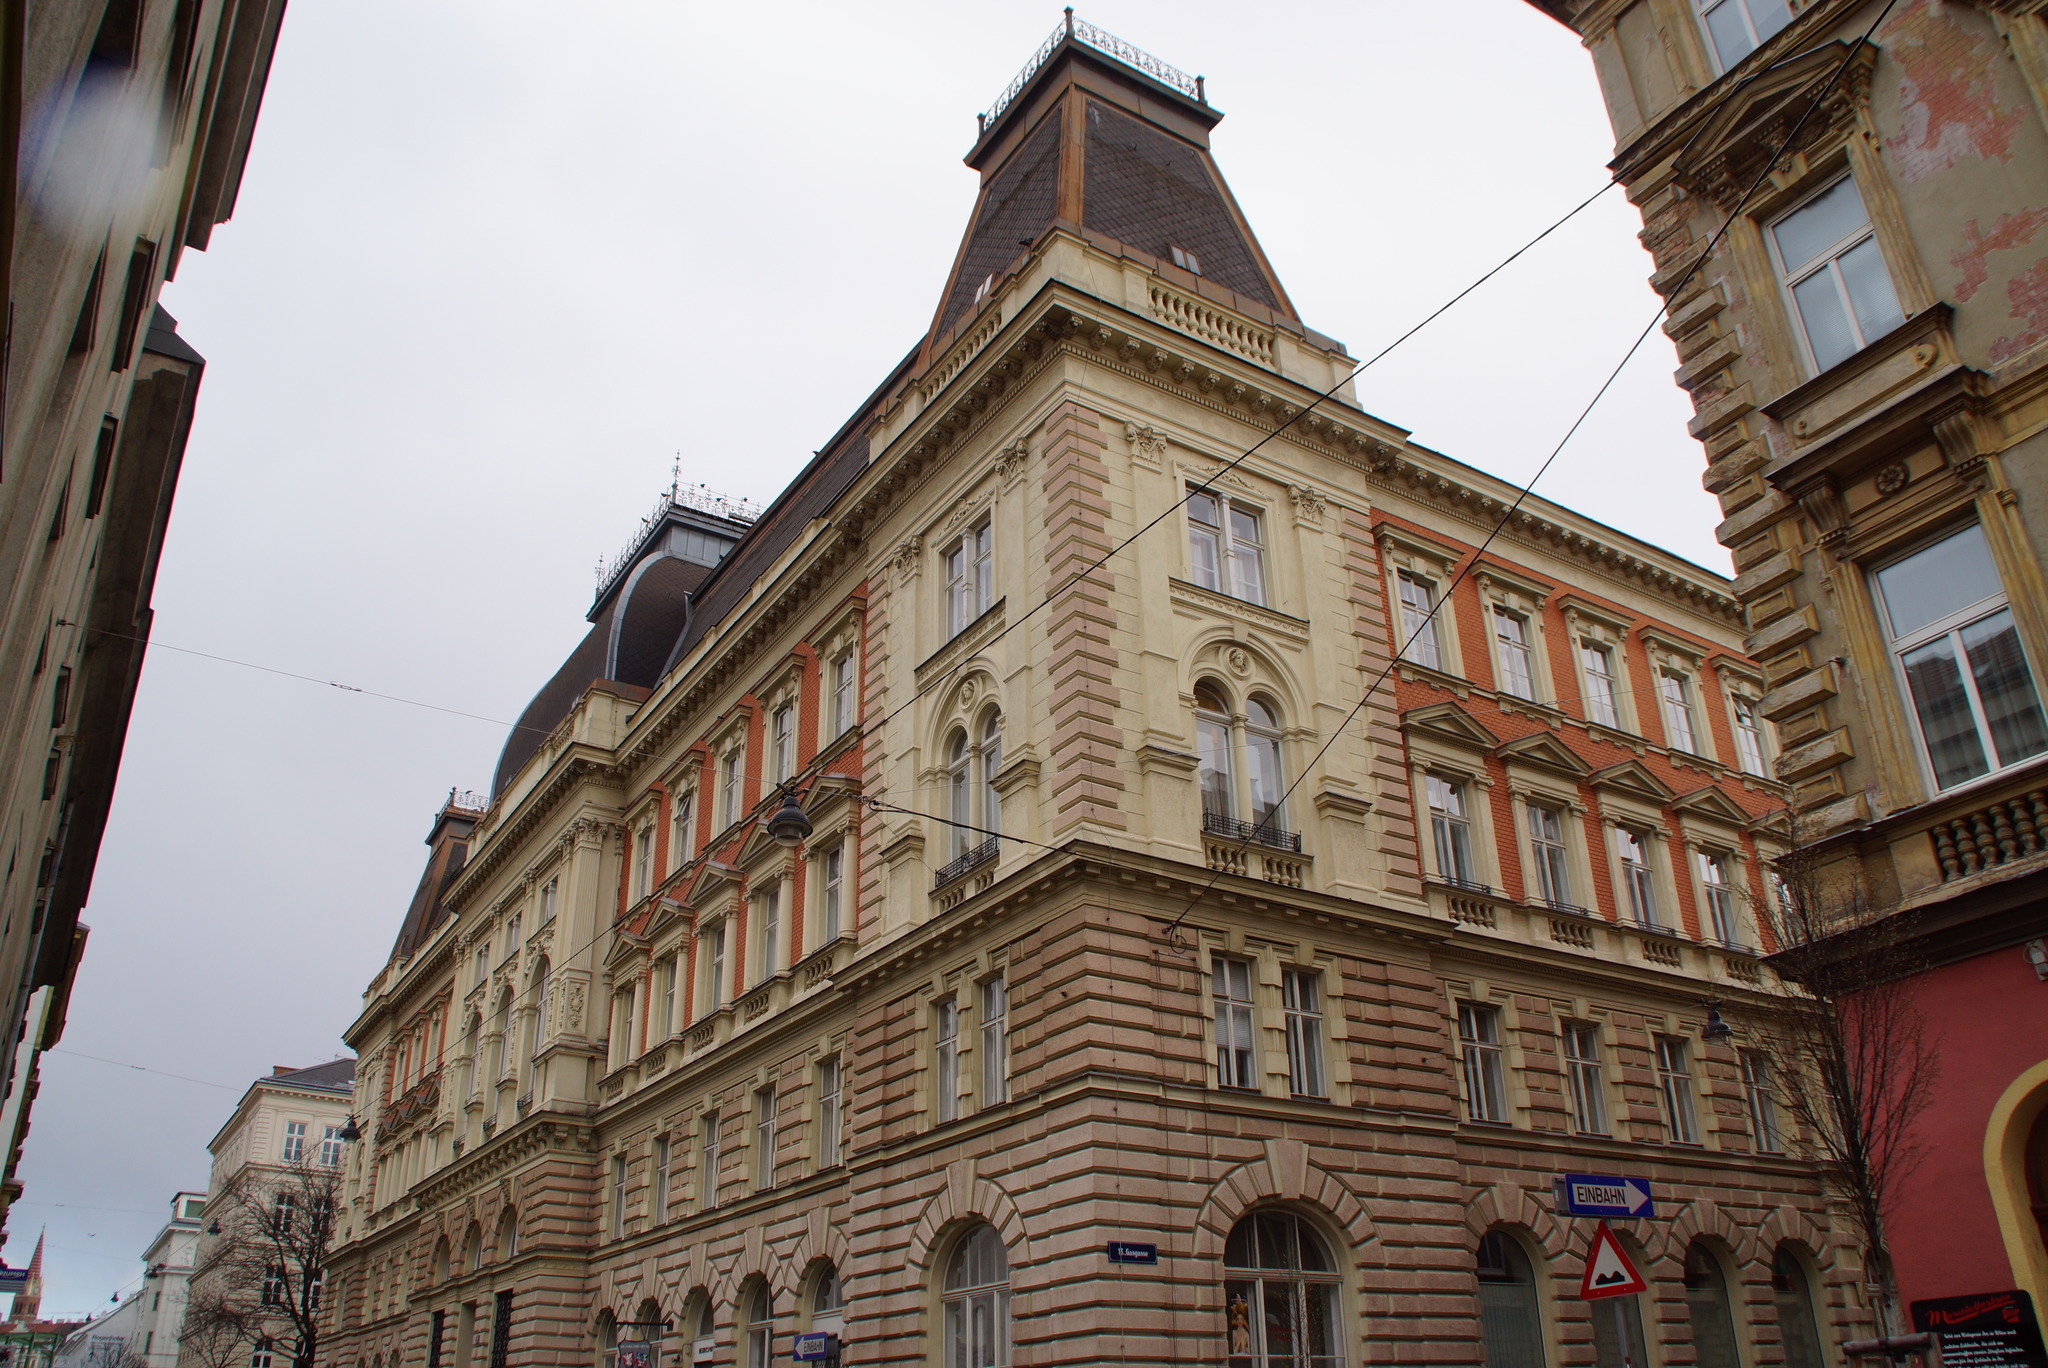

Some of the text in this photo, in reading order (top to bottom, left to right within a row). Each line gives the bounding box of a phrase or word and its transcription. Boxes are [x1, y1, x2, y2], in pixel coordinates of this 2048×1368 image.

[1576, 1186, 1626, 1205] EINBAHN
[1126, 1247, 1149, 1258] Gasgasse
[803, 1340, 823, 1353] EINBAHN
